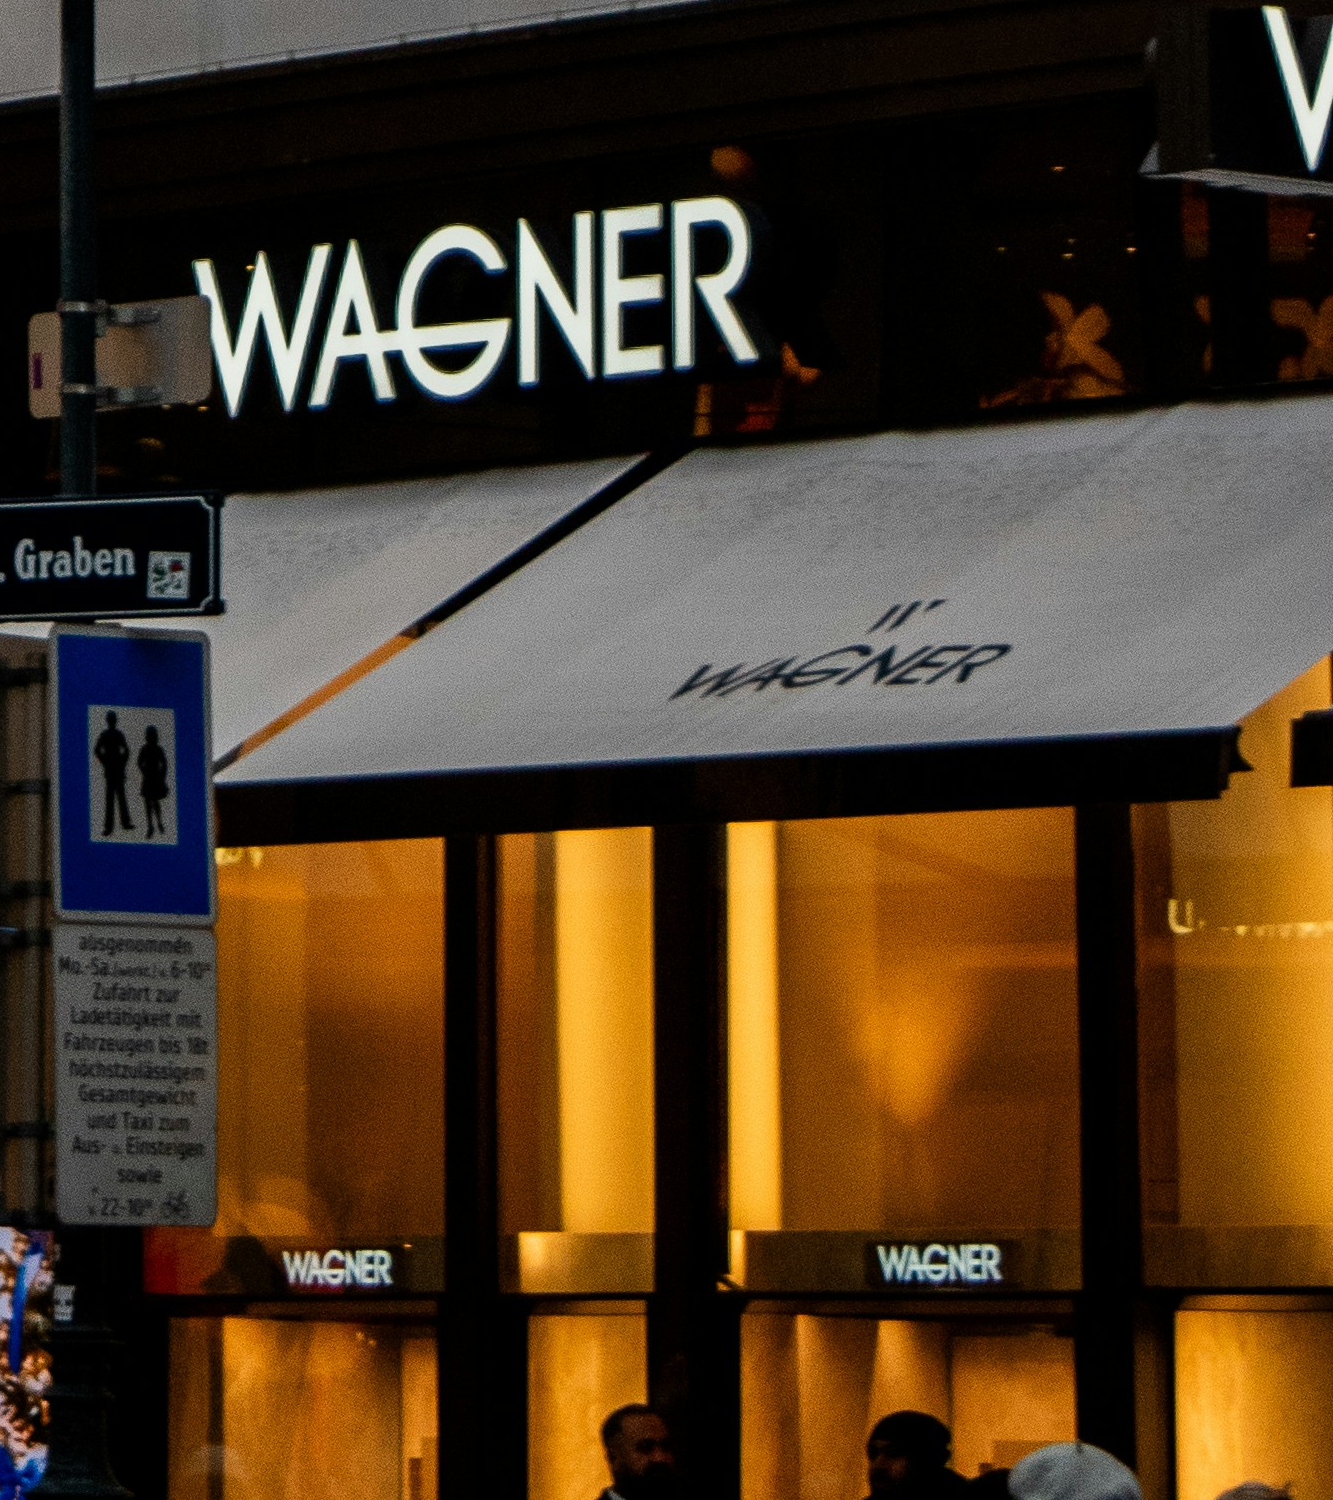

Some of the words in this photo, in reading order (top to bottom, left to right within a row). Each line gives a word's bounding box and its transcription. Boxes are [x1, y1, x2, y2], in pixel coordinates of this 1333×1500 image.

[192, 194, 760, 419] WAGNER
[14, 535, 136, 581] Graben
[668, 643, 1013, 701] WAGNER
[79, 935, 193, 957] ausgenommen
[93, 982, 150, 1002] Zufahrt
[155, 988, 182, 1003] zur
[175, 1010, 202, 1029] mit
[64, 1032, 155, 1057] Fahrzeugen
[157, 1036, 182, 1054] bis
[77, 1084, 197, 1108] Gesamtgewicht
[87, 1113, 117, 1130] und
[121, 1111, 154, 1131] Taxi
[157, 1116, 190, 1132] zum
[125, 1135, 205, 1160] Einsteigen
[117, 1164, 163, 1184] sowie
[281, 1249, 394, 1286] WAGNER
[876, 1243, 1004, 1283] WAGNER
